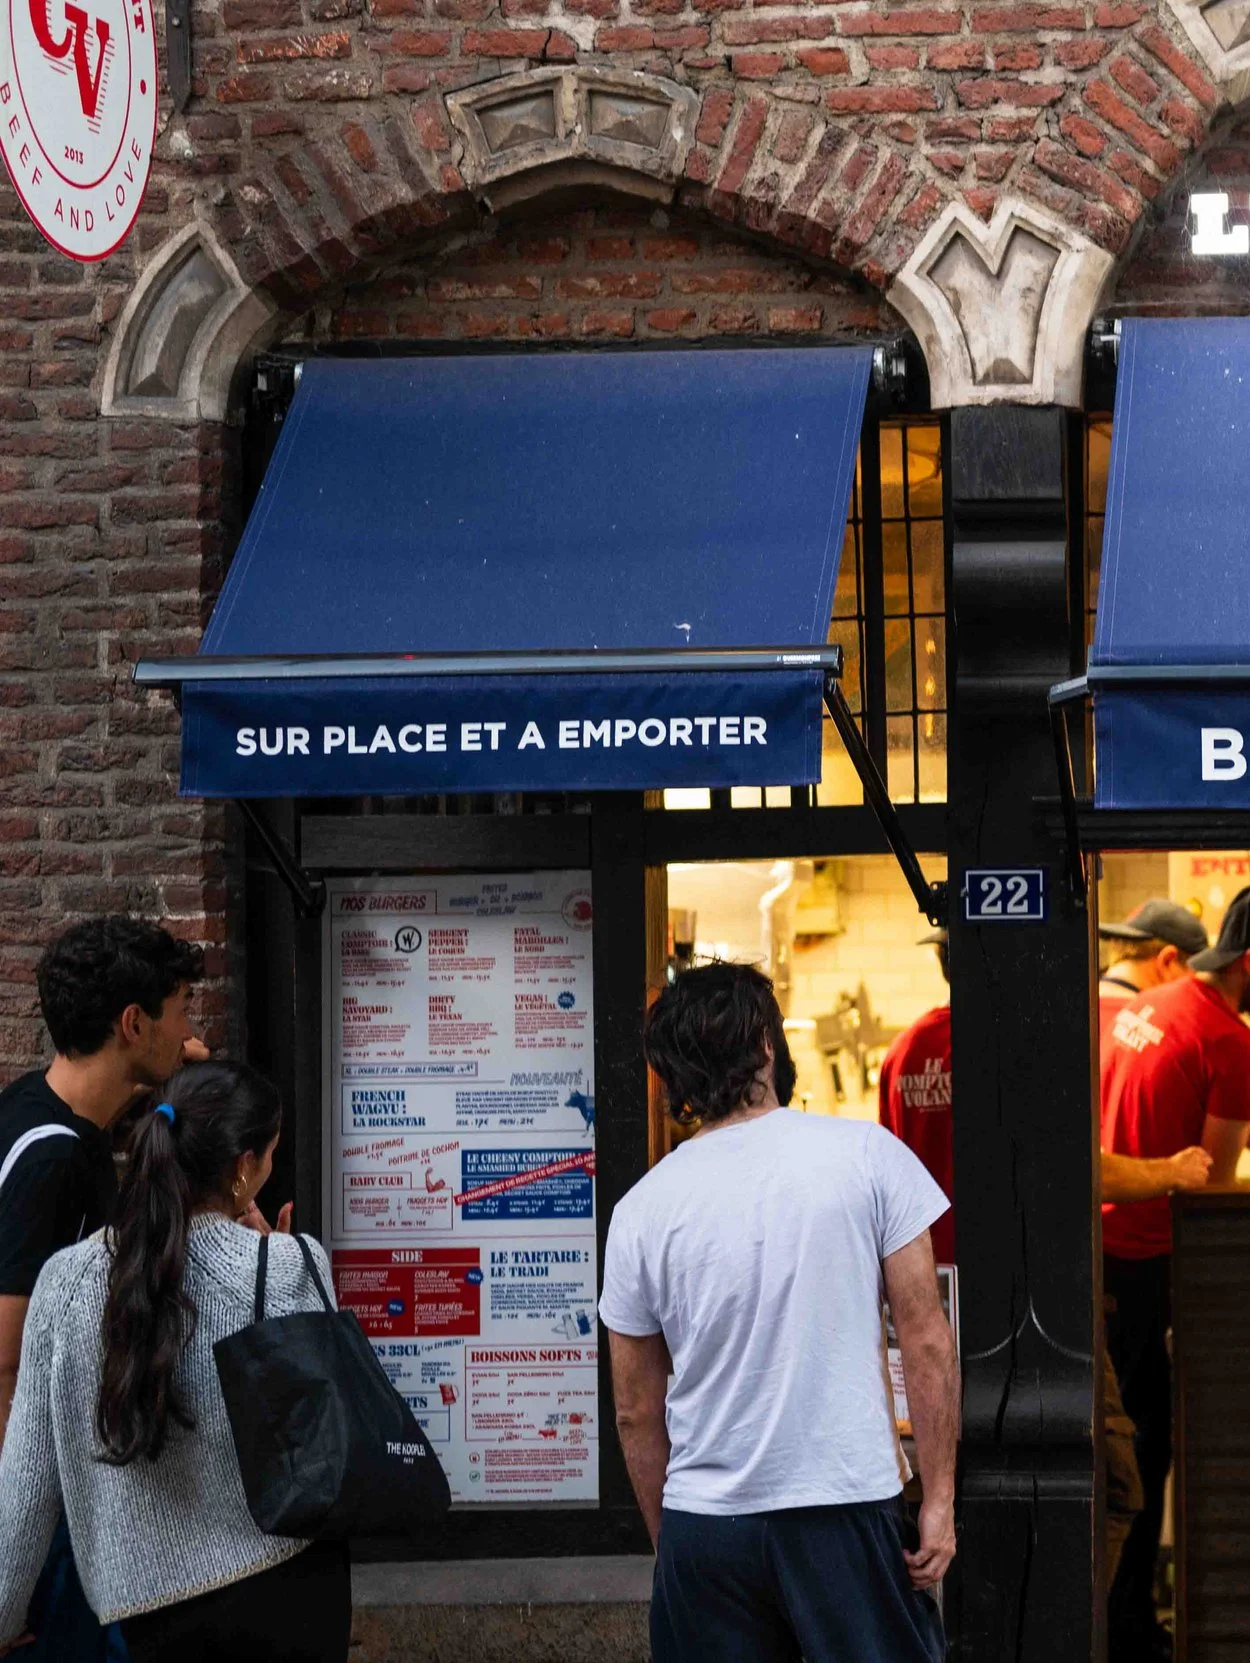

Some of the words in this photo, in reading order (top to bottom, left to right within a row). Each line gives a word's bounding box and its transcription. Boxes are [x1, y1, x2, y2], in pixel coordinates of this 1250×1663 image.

[0, 81, 43, 185] BEEF
[54, 198, 94, 232] AND
[105, 138, 142, 222] LOVE
[64, 145, 84, 164] 2013
[235, 727, 310, 757] SUR
[323, 723, 447, 755] PLACE
[461, 721, 506, 752] ET
[517, 720, 546, 751] A
[559, 716, 768, 748] EMPORTER
[981, 876, 1029, 914] 22
[368, 895, 427, 911] BURGERS
[924, 1058, 944, 1073] LE
[351, 1090, 405, 1102] FRENCH
[352, 1103, 399, 1115] WAGYU
[353, 1118, 366, 1127] LA
[368, 1117, 426, 1127] ROCKSTAR
[343, 1145, 369, 1158] DOUBLE
[371, 1137, 405, 1151] FROMAGE
[388, 1151, 419, 1166] POITRINE
[421, 1148, 430, 1158] DE
[432, 1140, 460, 1155] COCHON
[467, 1153, 479, 1163] LE
[481, 1152, 521, 1163] CHEESY
[467, 1164, 477, 1172] LE
[478, 1163, 516, 1172] SMASHED
[350, 1176, 377, 1187] BABY
[378, 1176, 403, 1186] CLUB
[457, 1183, 505, 1202] CHANGEMENT
[505, 1180, 516, 1188] DE
[516, 1171, 546, 1184] RECETTE
[391, 1250, 423, 1263] SIDE
[491, 1252, 508, 1264] LE
[512, 1250, 581, 1263] TARTARE
[491, 1267, 506, 1277] LE
[509, 1266, 549, 1277] TRADI
[389, 1344, 420, 1357] 33CL
[471, 1350, 536, 1362] BOISSONS
[540, 1349, 582, 1361] SOFTS
[386, 1441, 401, 1455] THE
